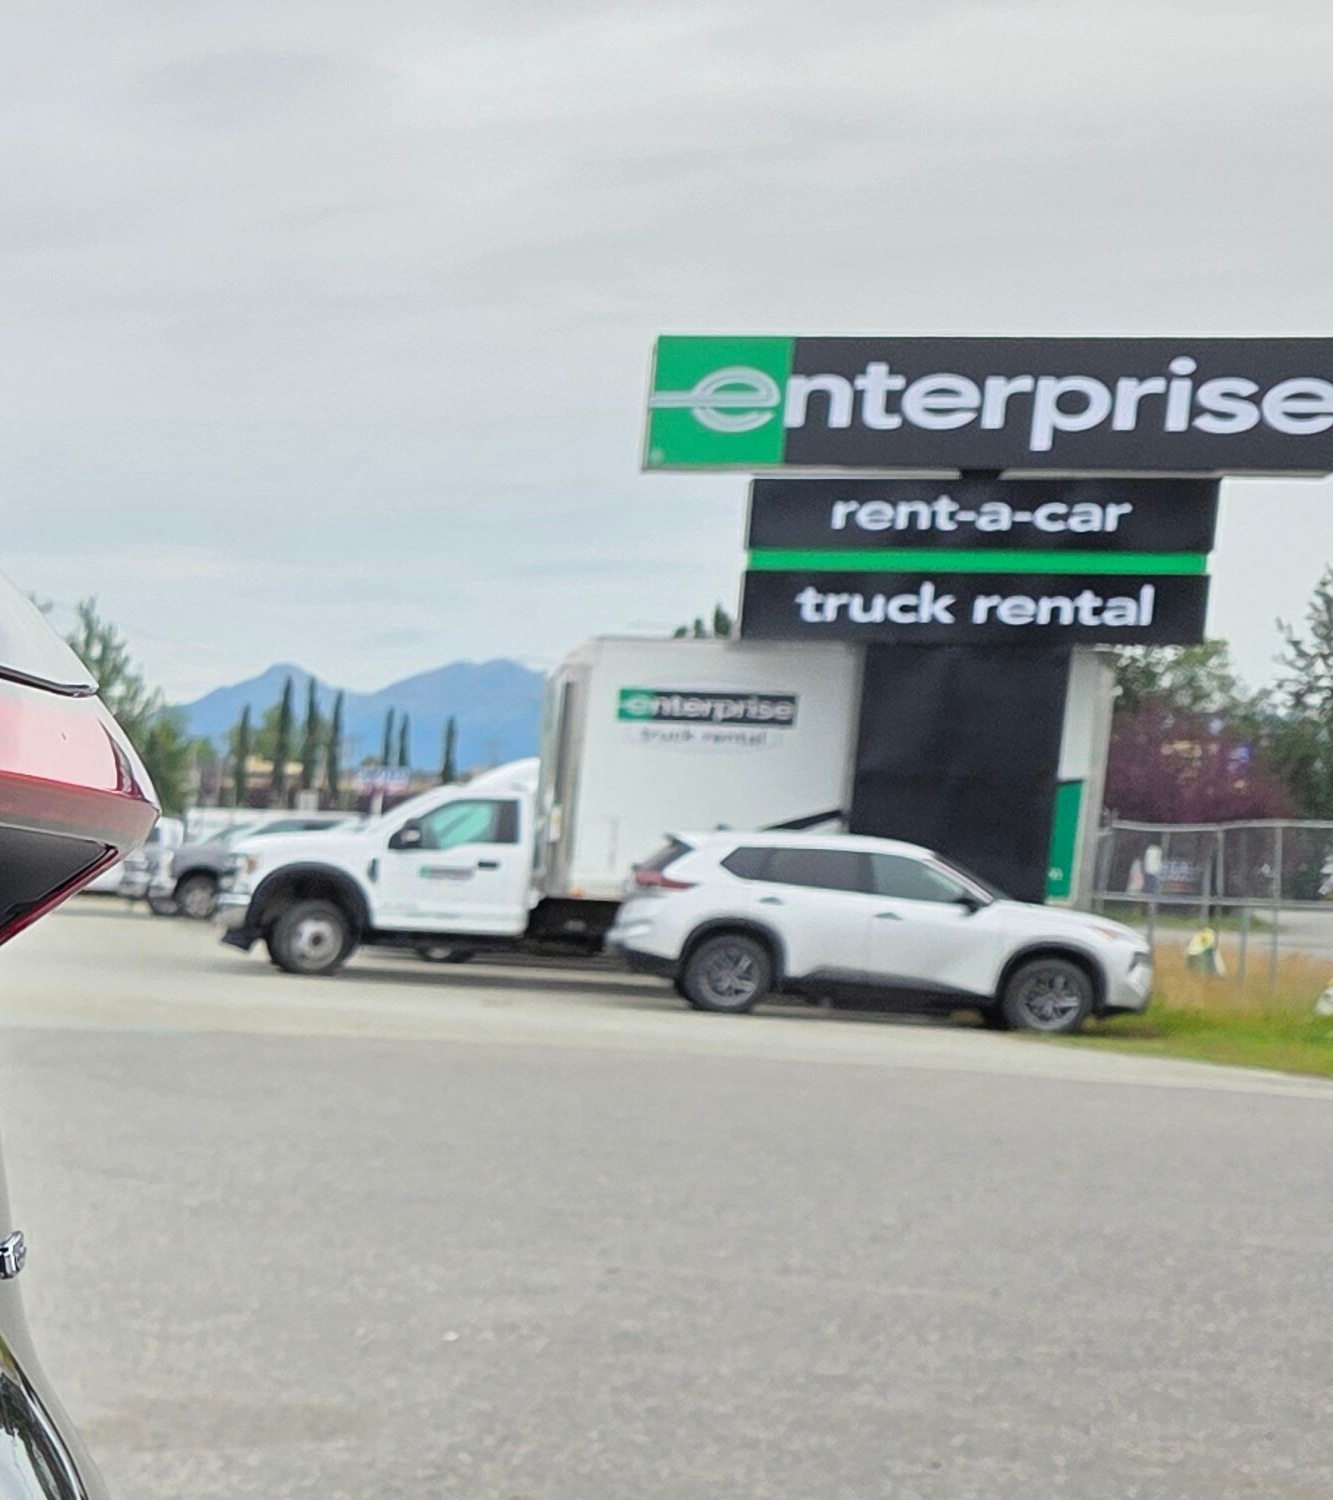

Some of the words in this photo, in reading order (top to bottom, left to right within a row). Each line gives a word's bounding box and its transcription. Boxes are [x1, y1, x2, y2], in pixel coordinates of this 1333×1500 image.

[650, 357, 1333, 451] enterprise
[831, 494, 1132, 533] rent-a-car
[795, 582, 955, 625] truck
[971, 583, 1156, 627] rental
[623, 693, 794, 722] enterprise
